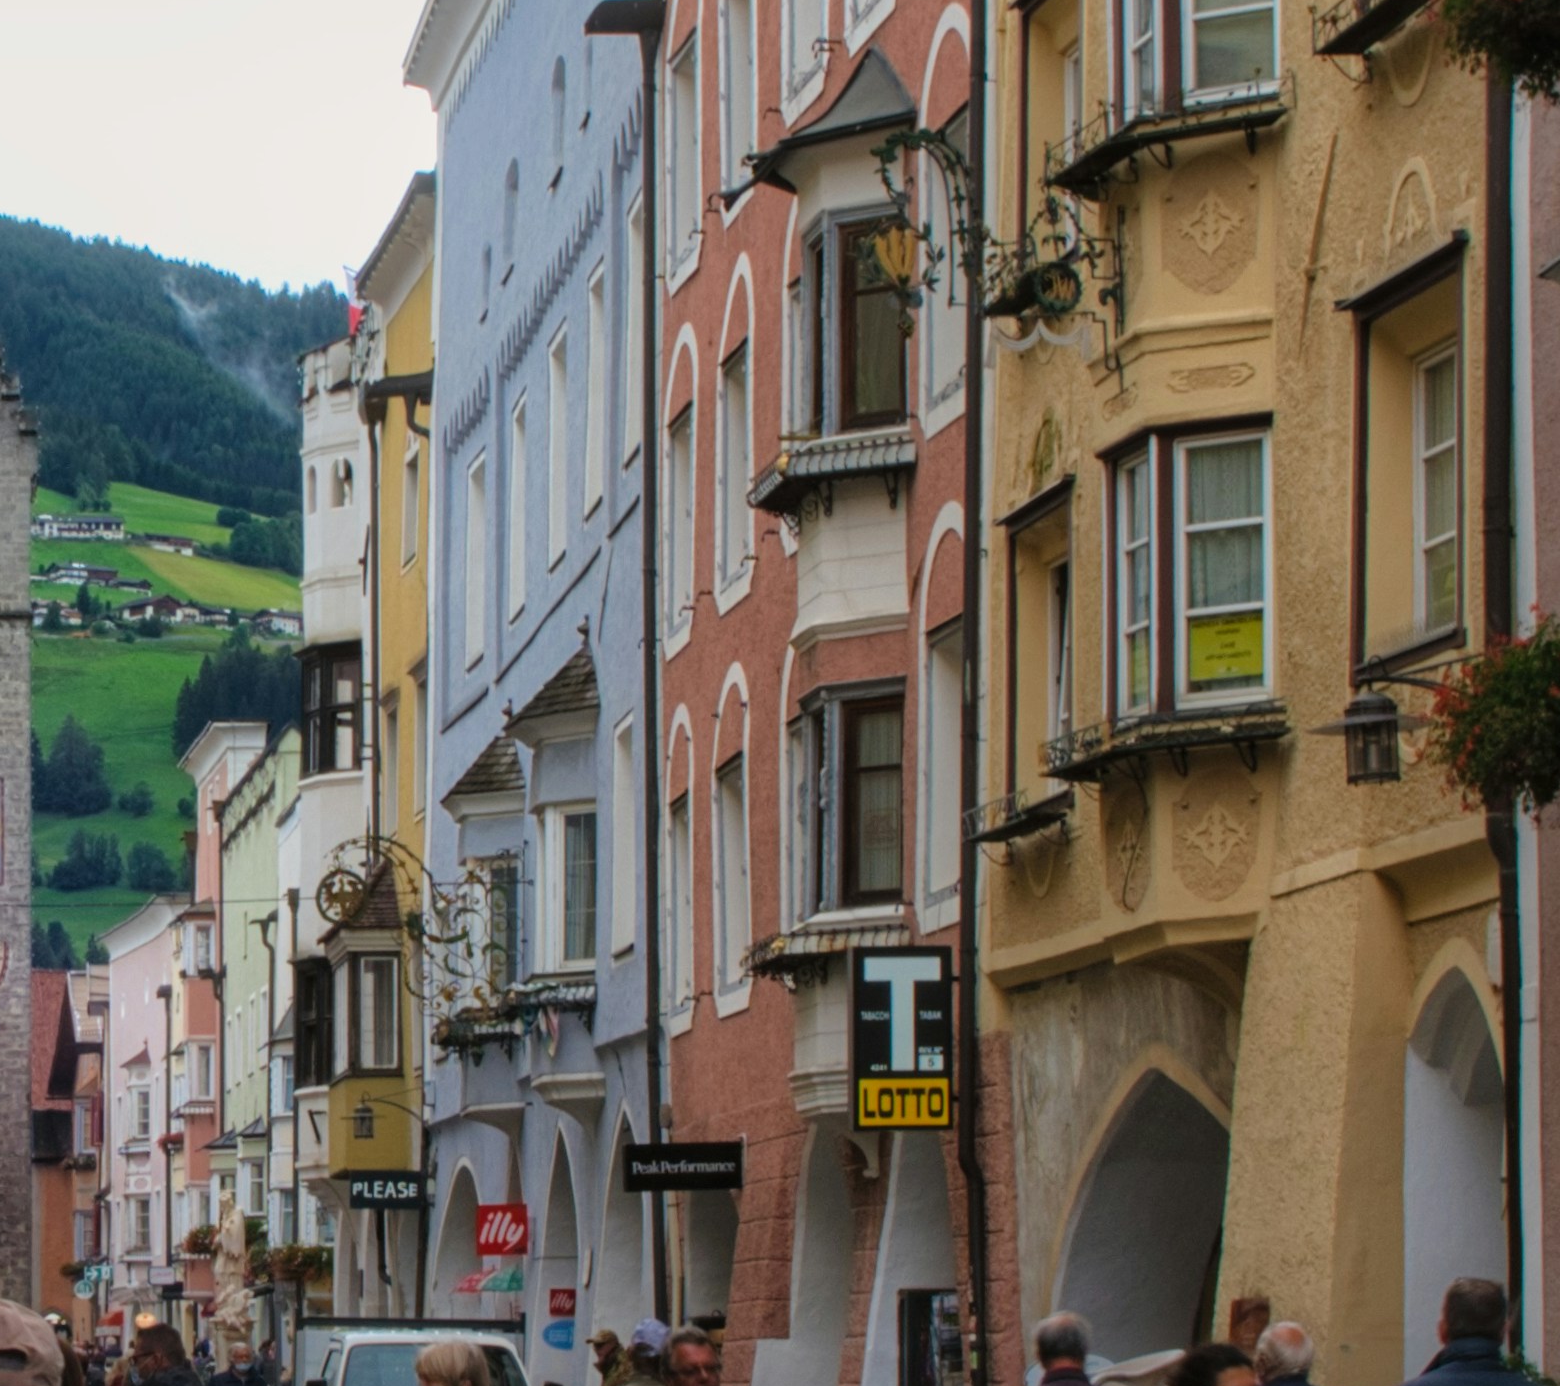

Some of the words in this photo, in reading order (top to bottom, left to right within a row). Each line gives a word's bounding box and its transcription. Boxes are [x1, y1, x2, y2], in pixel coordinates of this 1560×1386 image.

[863, 1086, 945, 1119] LOTTO
[352, 1178, 419, 1200] PLEASE
[480, 1210, 526, 1252] illy
[551, 1292, 574, 1312] illy
